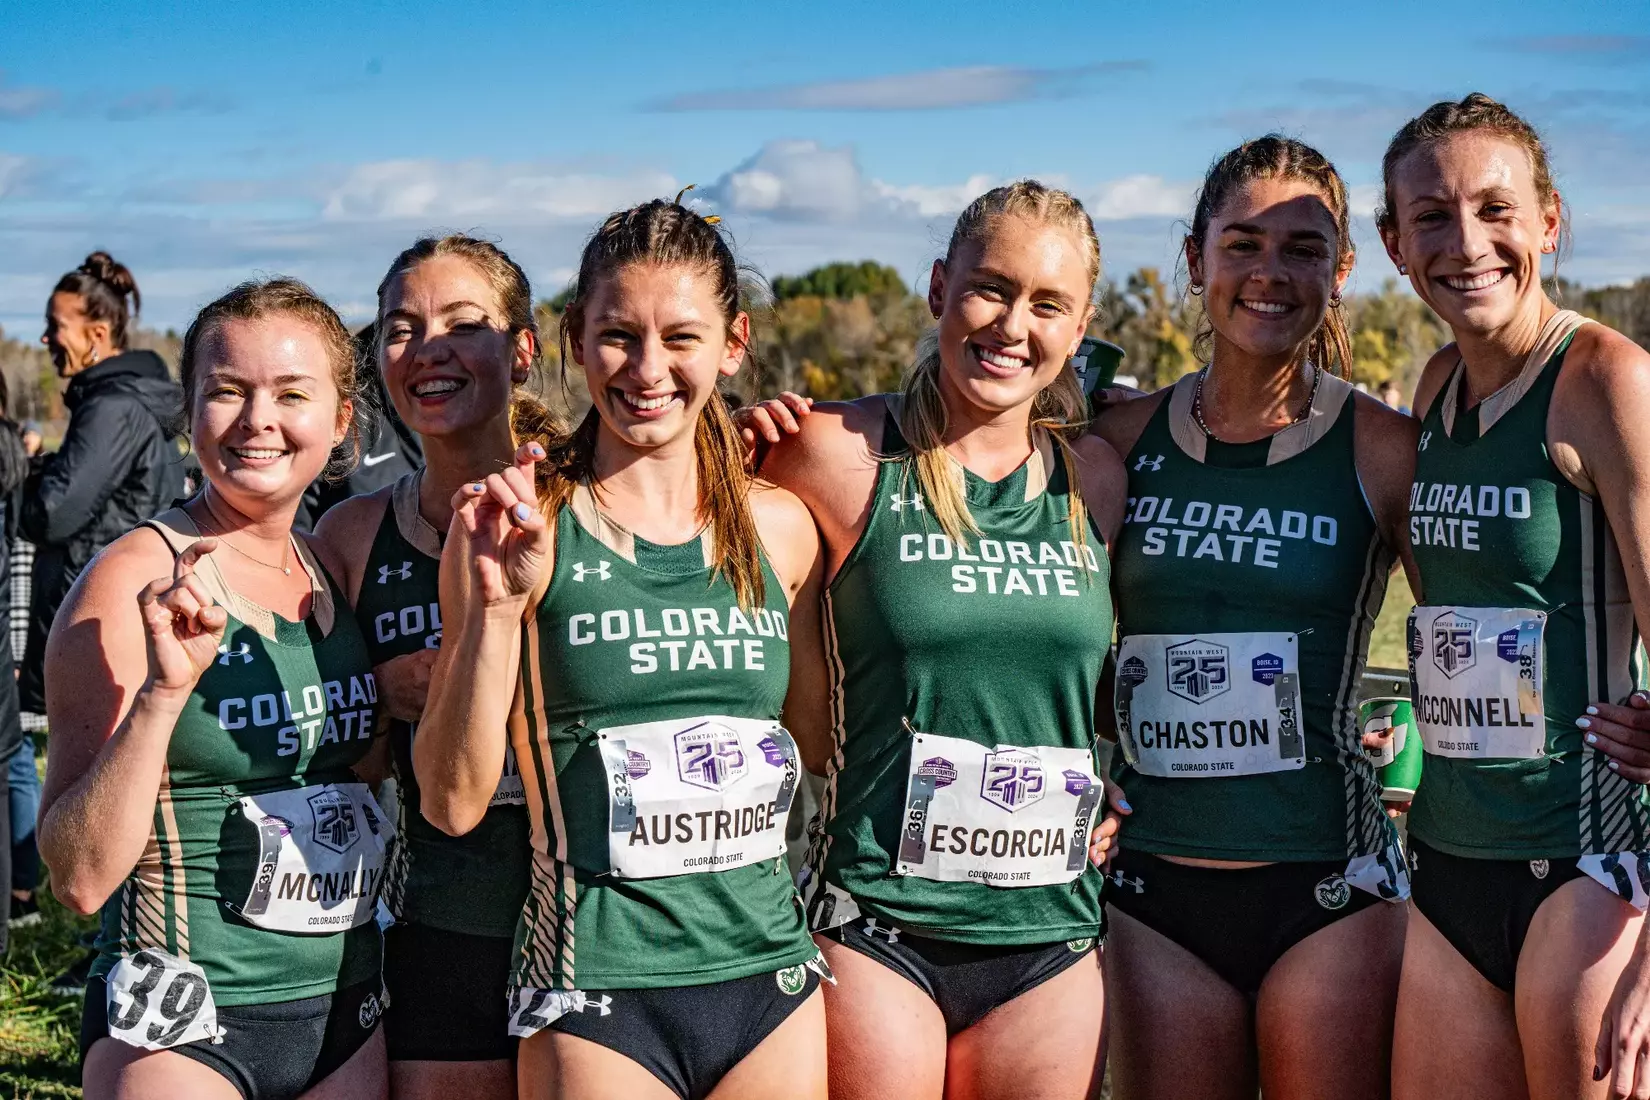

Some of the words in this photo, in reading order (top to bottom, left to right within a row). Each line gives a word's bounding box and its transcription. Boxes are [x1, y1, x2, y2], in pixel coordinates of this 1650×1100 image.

[1409, 482, 1531, 519] OLORADO
[1142, 527, 1282, 569] STATE
[1411, 516, 1480, 551] STATE
[900, 534, 1099, 573] COLORADO
[951, 564, 1080, 597] STATE
[568, 607, 788, 646] COLORADO
[629, 639, 765, 674] STATE
[1435, 629, 1472, 658] 25
[1171, 656, 1226, 684] 25
[1520, 655, 1532, 679] 38
[218, 672, 378, 731] COLORAD
[1416, 695, 1534, 728] MCCONNELL
[1280, 707, 1292, 728] 34
[277, 709, 373, 757] STATE
[1139, 719, 1270, 749] CHASTON
[1458, 742, 1479, 751] STATE
[681, 741, 745, 774] 25
[785, 758, 795, 783] 32
[1171, 763, 1209, 772] COLORADO
[1211, 762, 1235, 771] STATE
[614, 773, 628, 797] 32
[935, 769, 956, 778] COUNTRY
[987, 764, 1043, 793] 25
[316, 804, 356, 835] 25
[629, 801, 777, 846] AUSTRIDGE
[908, 811, 923, 832] 36
[1074, 818, 1086, 838] 36
[930, 824, 1066, 858] ESCORCIA
[259, 863, 274, 885] 39
[683, 856, 724, 867] COLORADO
[726, 852, 744, 864] STATE
[277, 868, 380, 902] MCNALLY
[968, 870, 1009, 880] COLORADO
[1010, 871, 1031, 881] STATE
[308, 916, 341, 925] COLORADO
[108, 951, 208, 1047] 39
